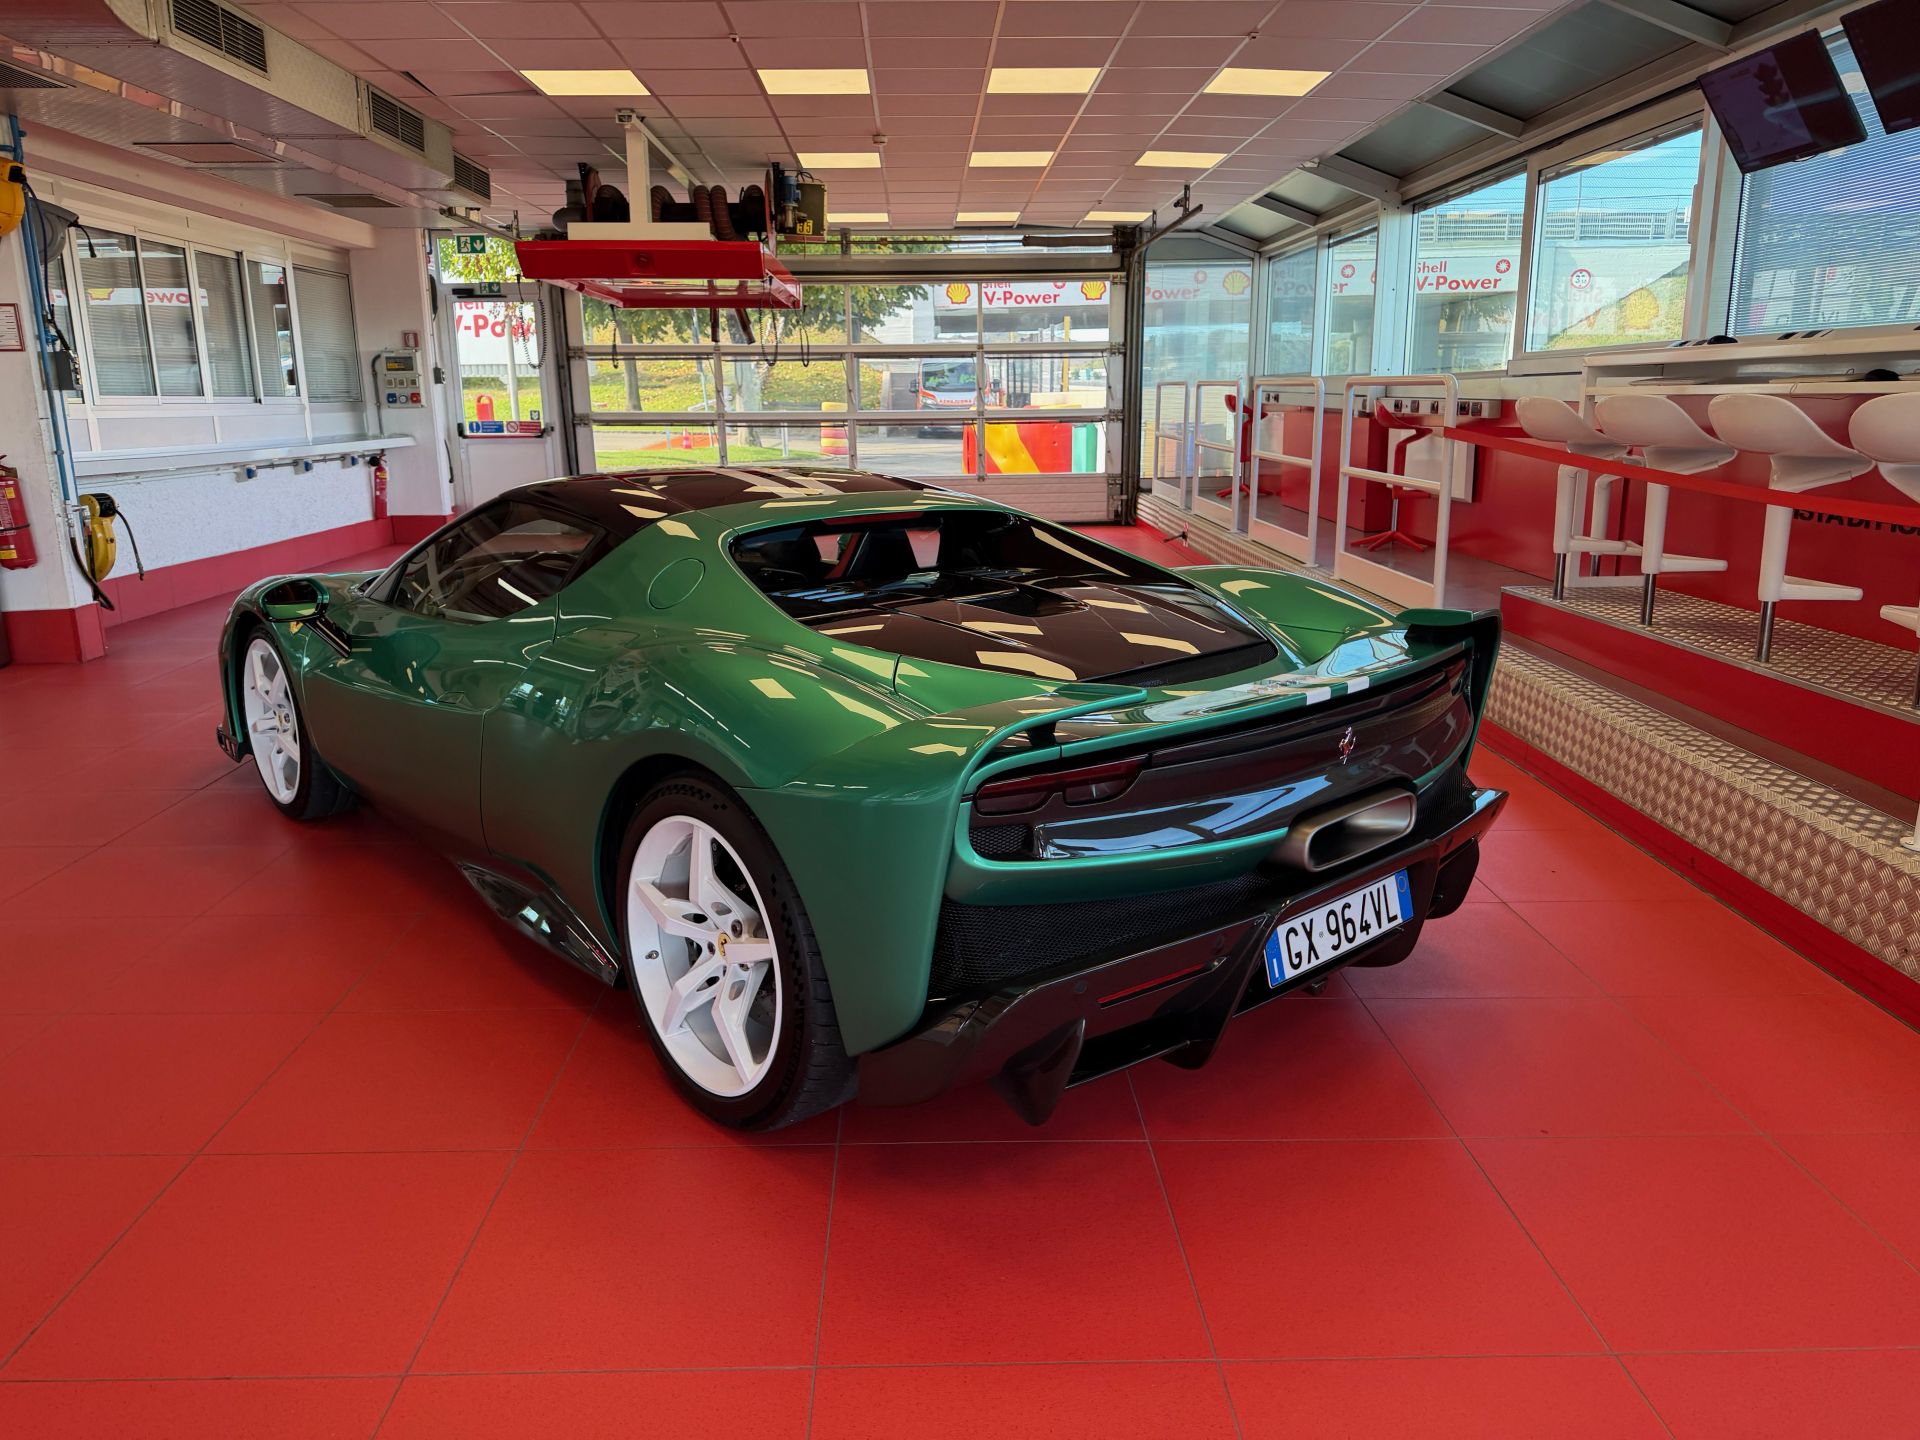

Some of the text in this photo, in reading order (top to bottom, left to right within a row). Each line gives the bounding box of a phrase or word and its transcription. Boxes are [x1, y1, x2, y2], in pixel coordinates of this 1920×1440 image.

[1416, 276, 1502, 291] V-Power
[983, 291, 1060, 305] V-Power
[1285, 884, 1399, 970] GX 964VL
